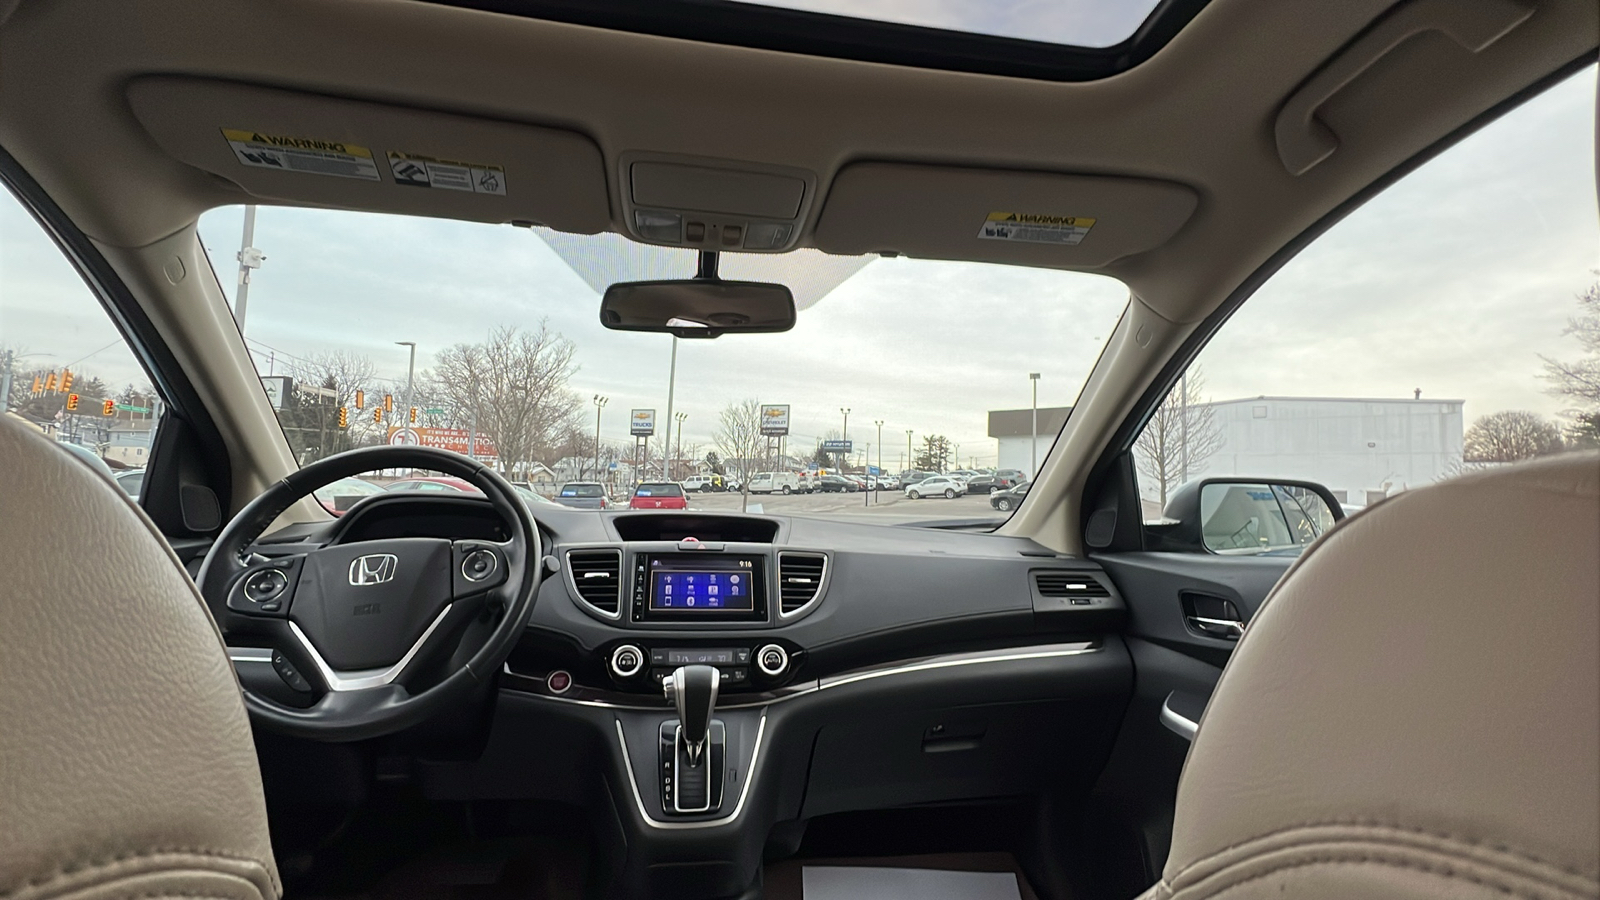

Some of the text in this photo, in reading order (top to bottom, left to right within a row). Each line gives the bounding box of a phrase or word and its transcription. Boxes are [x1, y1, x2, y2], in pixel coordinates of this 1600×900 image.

[267, 135, 347, 153] WARNING
[1020, 213, 1076, 225] WARNING
[422, 435, 496, 446] TRANS4MTION
[739, 560, 753, 568] 9:16
